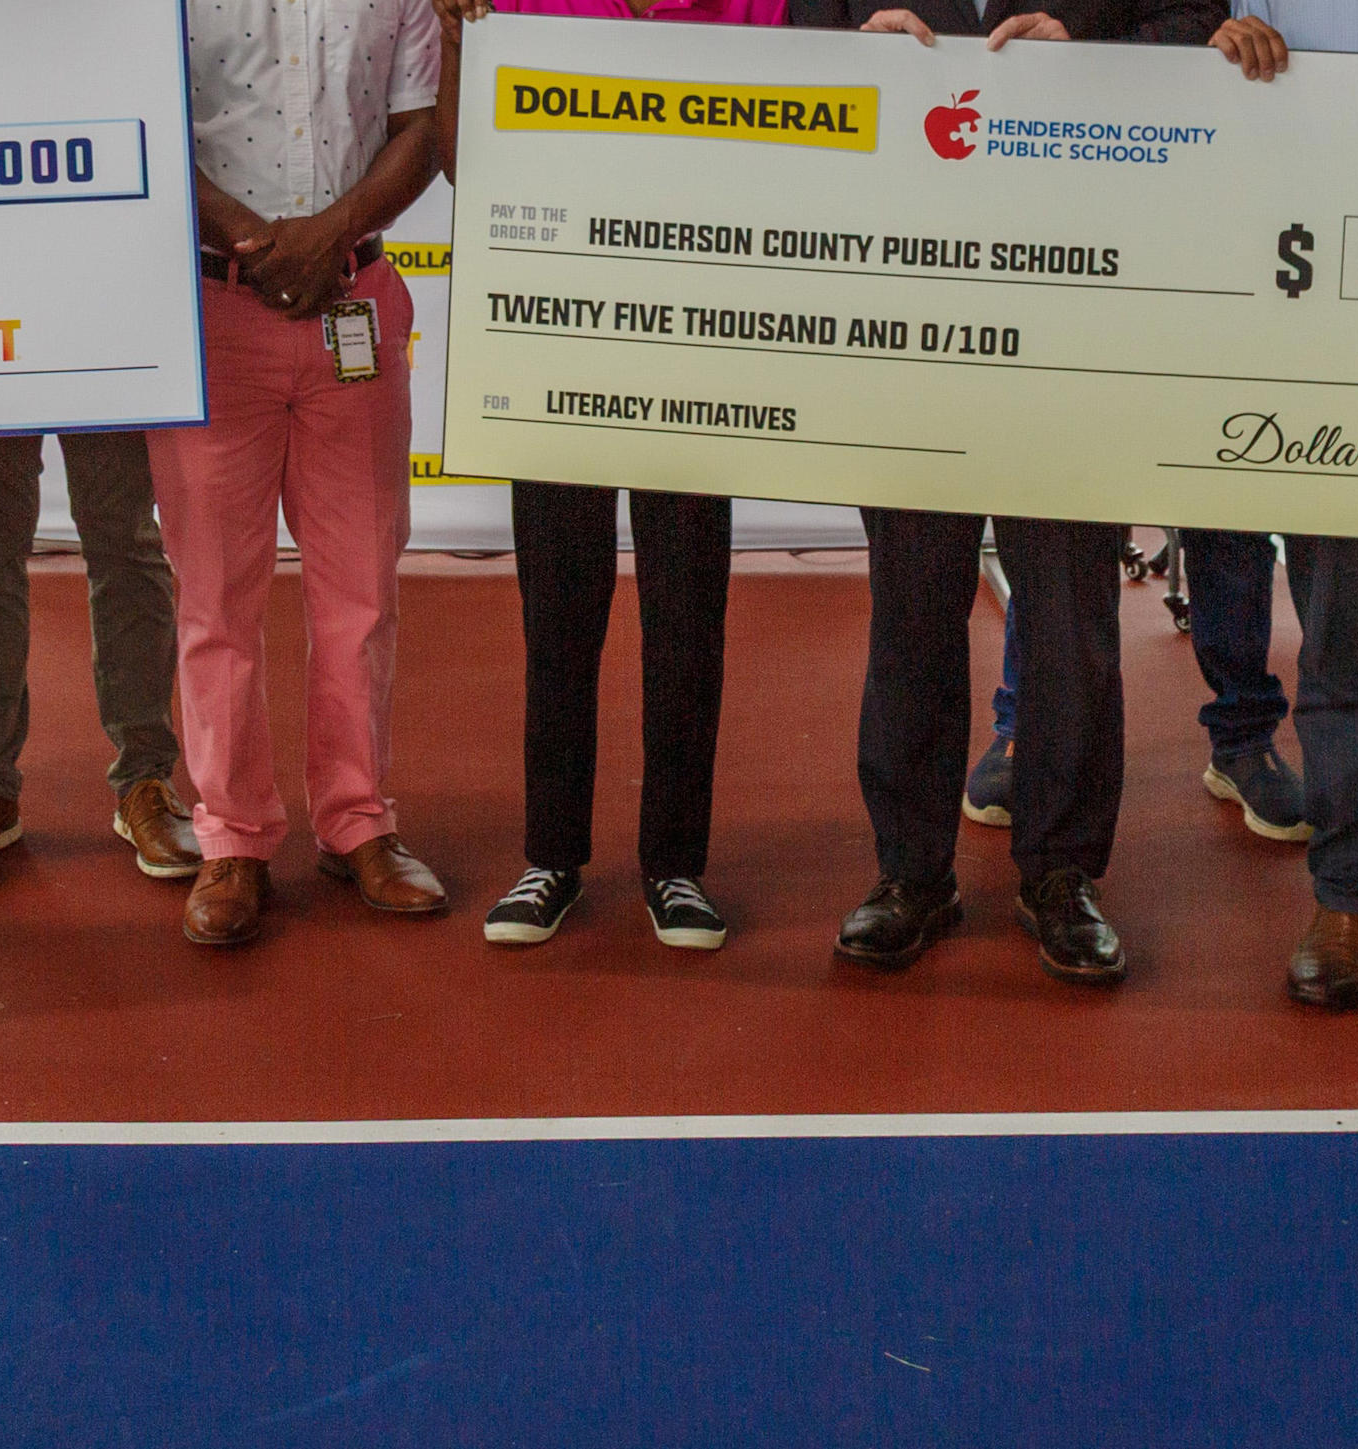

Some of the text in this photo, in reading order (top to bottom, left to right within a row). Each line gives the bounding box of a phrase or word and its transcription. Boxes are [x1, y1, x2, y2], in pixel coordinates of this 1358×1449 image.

[513, 84, 859, 134] DOLLAR GENERAL
[987, 140, 1168, 163] PUBLIC SCHOOLS
[988, 118, 1216, 145] HENDERSON COUNTY
[490, 203, 568, 223] PAY TO THE
[490, 223, 558, 242] ORDER OF
[589, 217, 1119, 276] HENDERSON COUNTY PUBLIC SCHOOLS
[1276, 223, 1314, 298] $
[487, 292, 1020, 357] TWENTY FIVE THOUSAND AND 0/100
[483, 390, 797, 432] FOR LITERACY INITIATIVES
